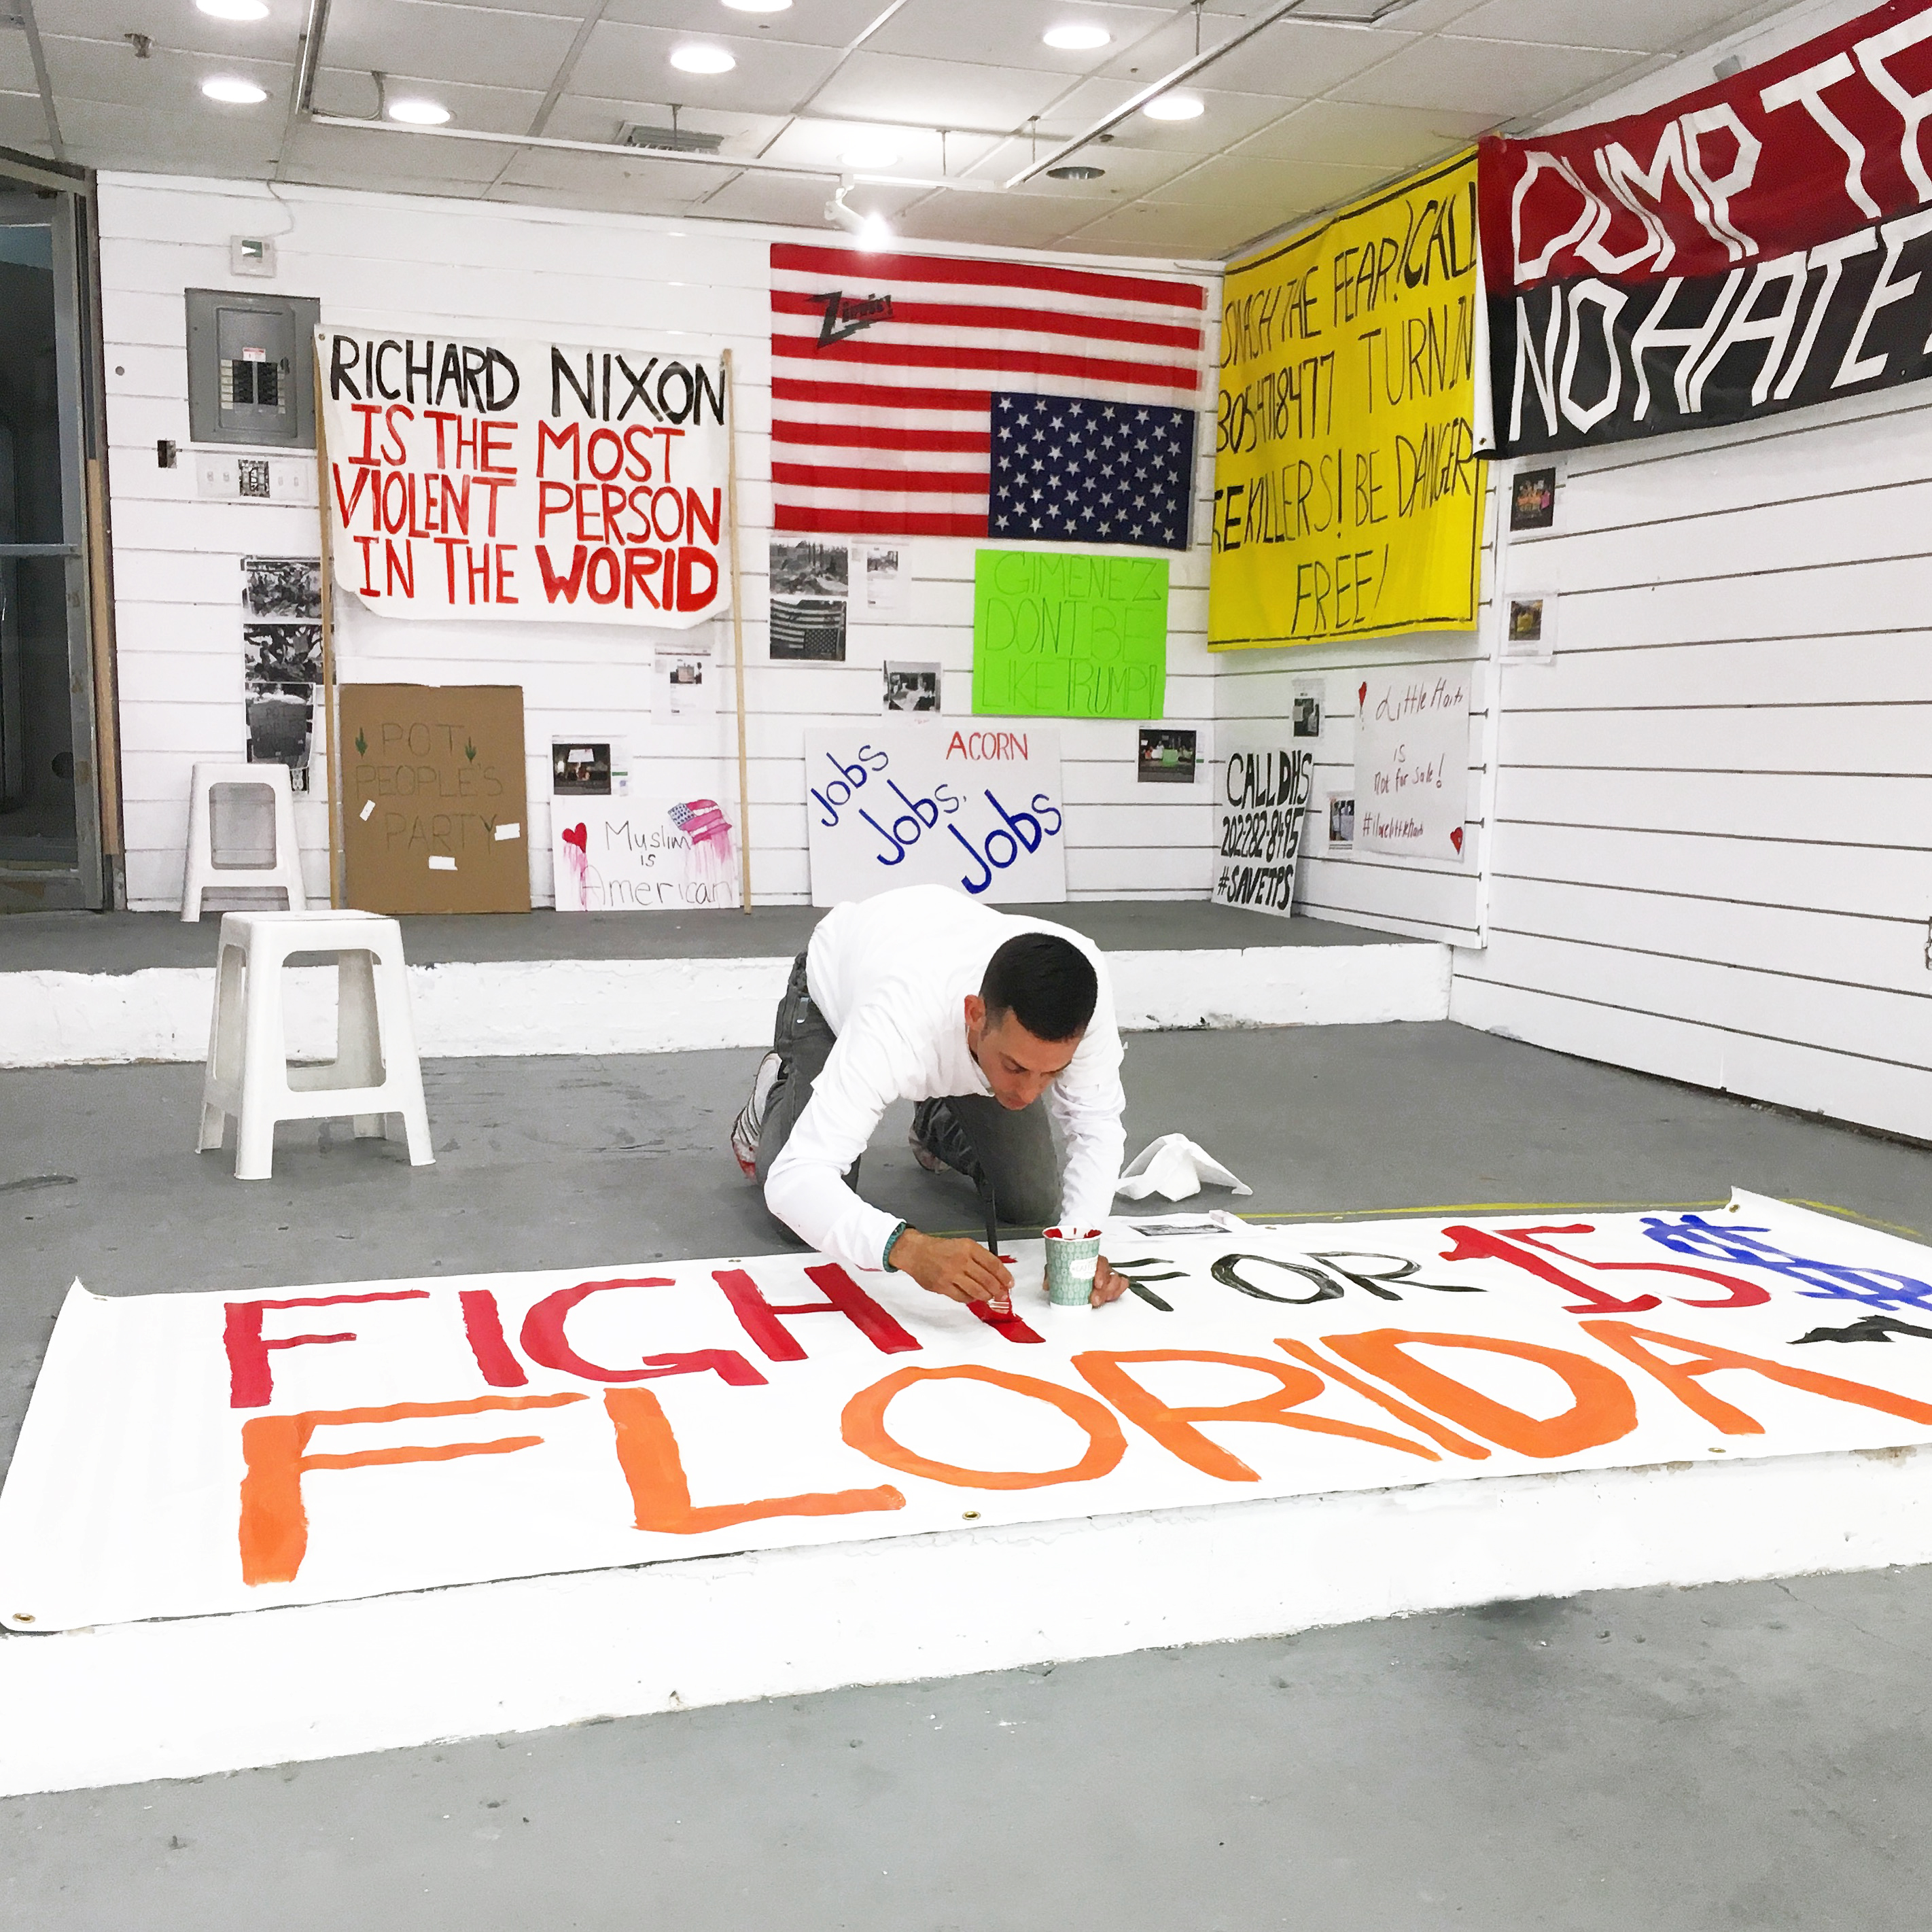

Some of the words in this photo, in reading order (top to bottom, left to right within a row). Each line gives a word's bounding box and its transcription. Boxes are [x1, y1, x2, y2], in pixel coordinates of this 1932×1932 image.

[1511, 103, 1762, 285] DUMP
[1280, 265, 1322, 343] THE
[331, 334, 519, 414] RICHARD
[552, 343, 726, 425] NIXON
[1358, 304, 1447, 412] TURN
[348, 404, 414, 467] IS
[424, 410, 519, 475] THE
[537, 419, 686, 483] MOST
[333, 463, 517, 538] VIOLENT
[539, 480, 722, 546] PERSON
[1356, 449, 1388, 527] BE
[353, 536, 415, 599] IN
[434, 538, 519, 604] THE
[994, 551, 1162, 602] GIMENEZ
[1091, 606, 1155, 665] BE
[982, 657, 1056, 709] LIKE
[1056, 657, 1158, 719] TRUMP!
[1375, 680, 1427, 722] Little
[382, 722, 465, 756] POT
[946, 731, 1028, 761] ACORN
[355, 763, 504, 802] PEOPLE'S
[811, 745, 890, 827] Jobs
[1227, 752, 1276, 810] CALL
[1276, 750, 1313, 807] DHS
[384, 813, 497, 854] PARTY
[605, 820, 692, 851] Muslim
[641, 854, 656, 866] is
[947, 789, 1063, 894] Jobs
[580, 864, 733, 907] American
[238, 1320, 1932, 1587] FLORIDA
